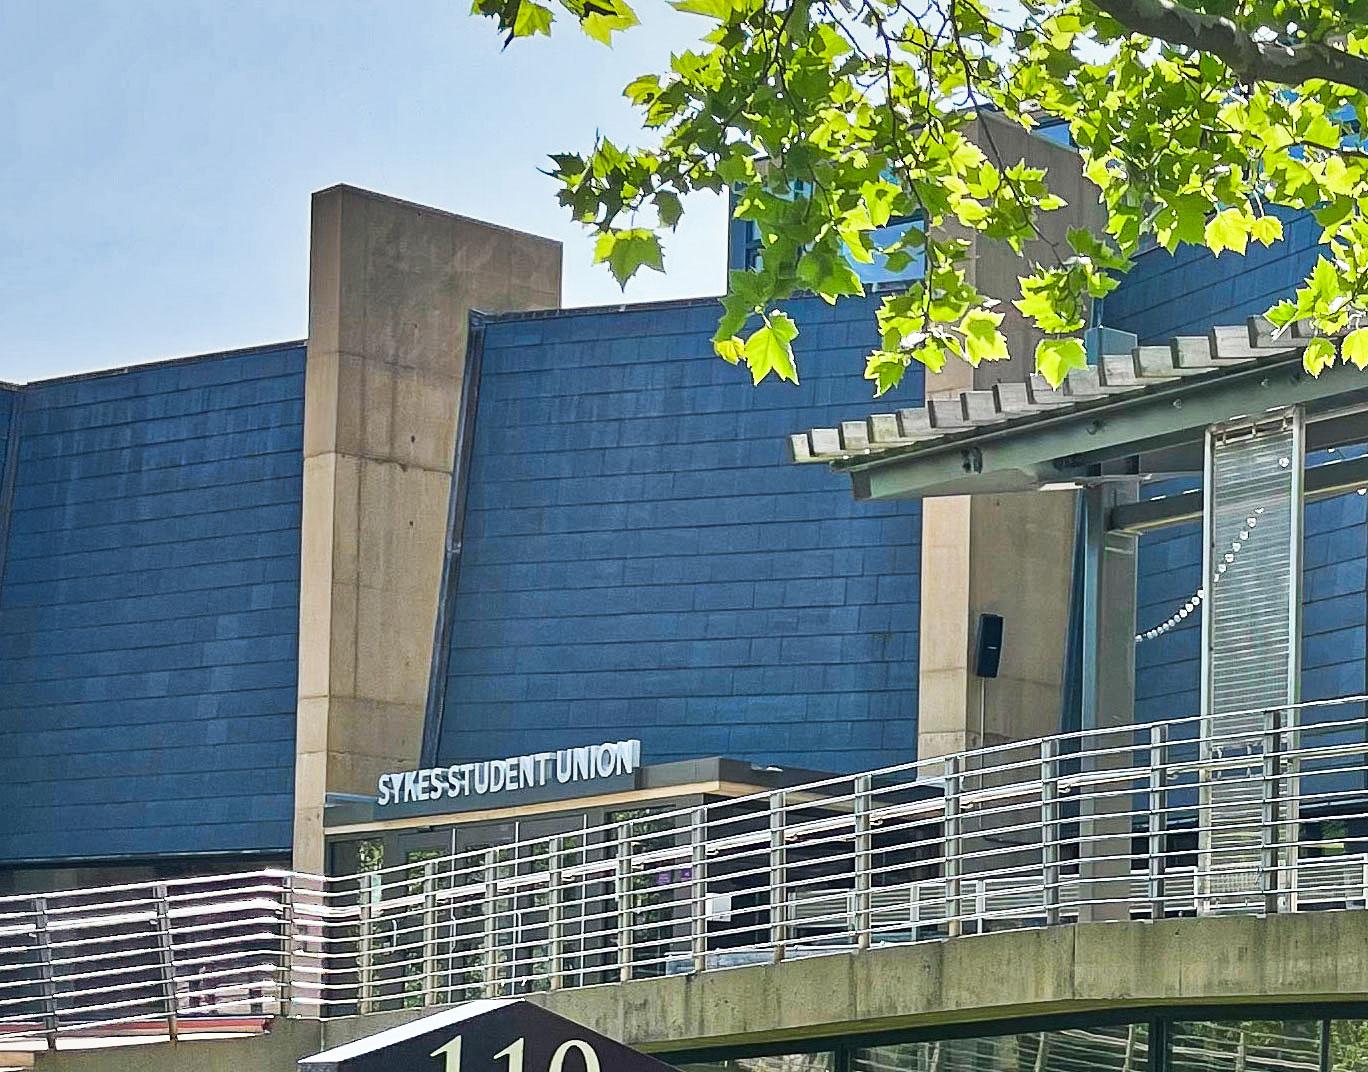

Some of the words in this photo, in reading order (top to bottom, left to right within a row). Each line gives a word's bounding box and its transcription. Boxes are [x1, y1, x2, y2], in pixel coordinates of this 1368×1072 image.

[377, 768, 449, 806] SYKES
[447, 752, 555, 798] STUDENT
[555, 739, 640, 784] UNION
